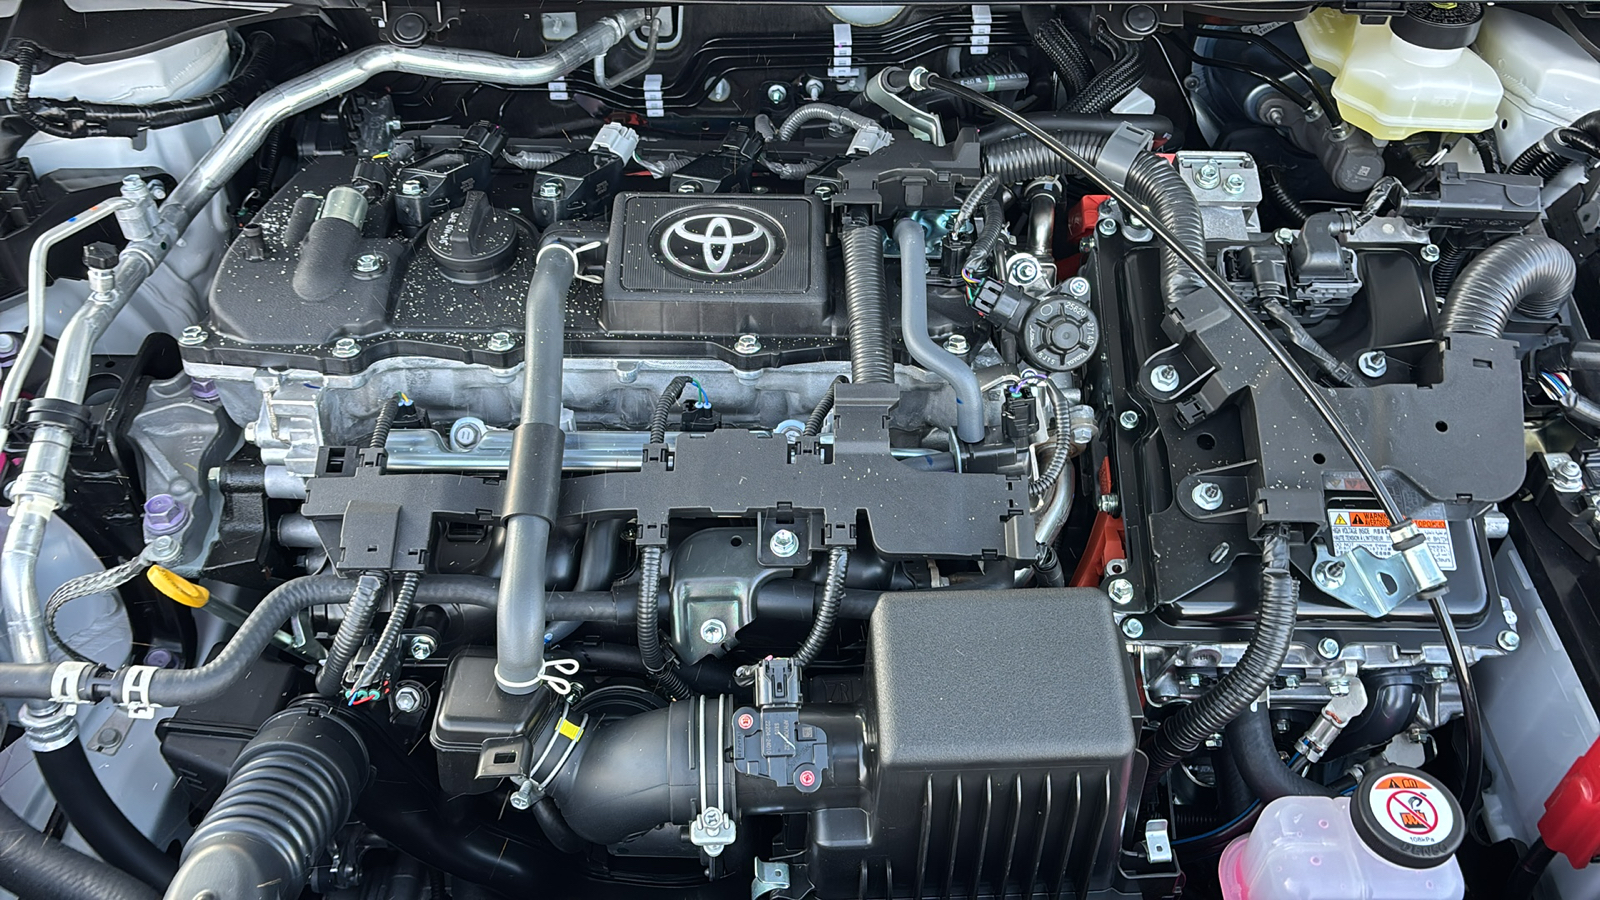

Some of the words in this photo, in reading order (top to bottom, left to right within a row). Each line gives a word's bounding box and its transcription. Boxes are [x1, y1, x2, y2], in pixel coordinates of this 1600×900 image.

[447, 211, 460, 224] SAE
[1065, 301, 1087, 317] 25620
[1087, 322, 1095, 345] 37140
[1066, 352, 1088, 367] TOYOTA
[1400, 842, 1448, 856] DENSO
